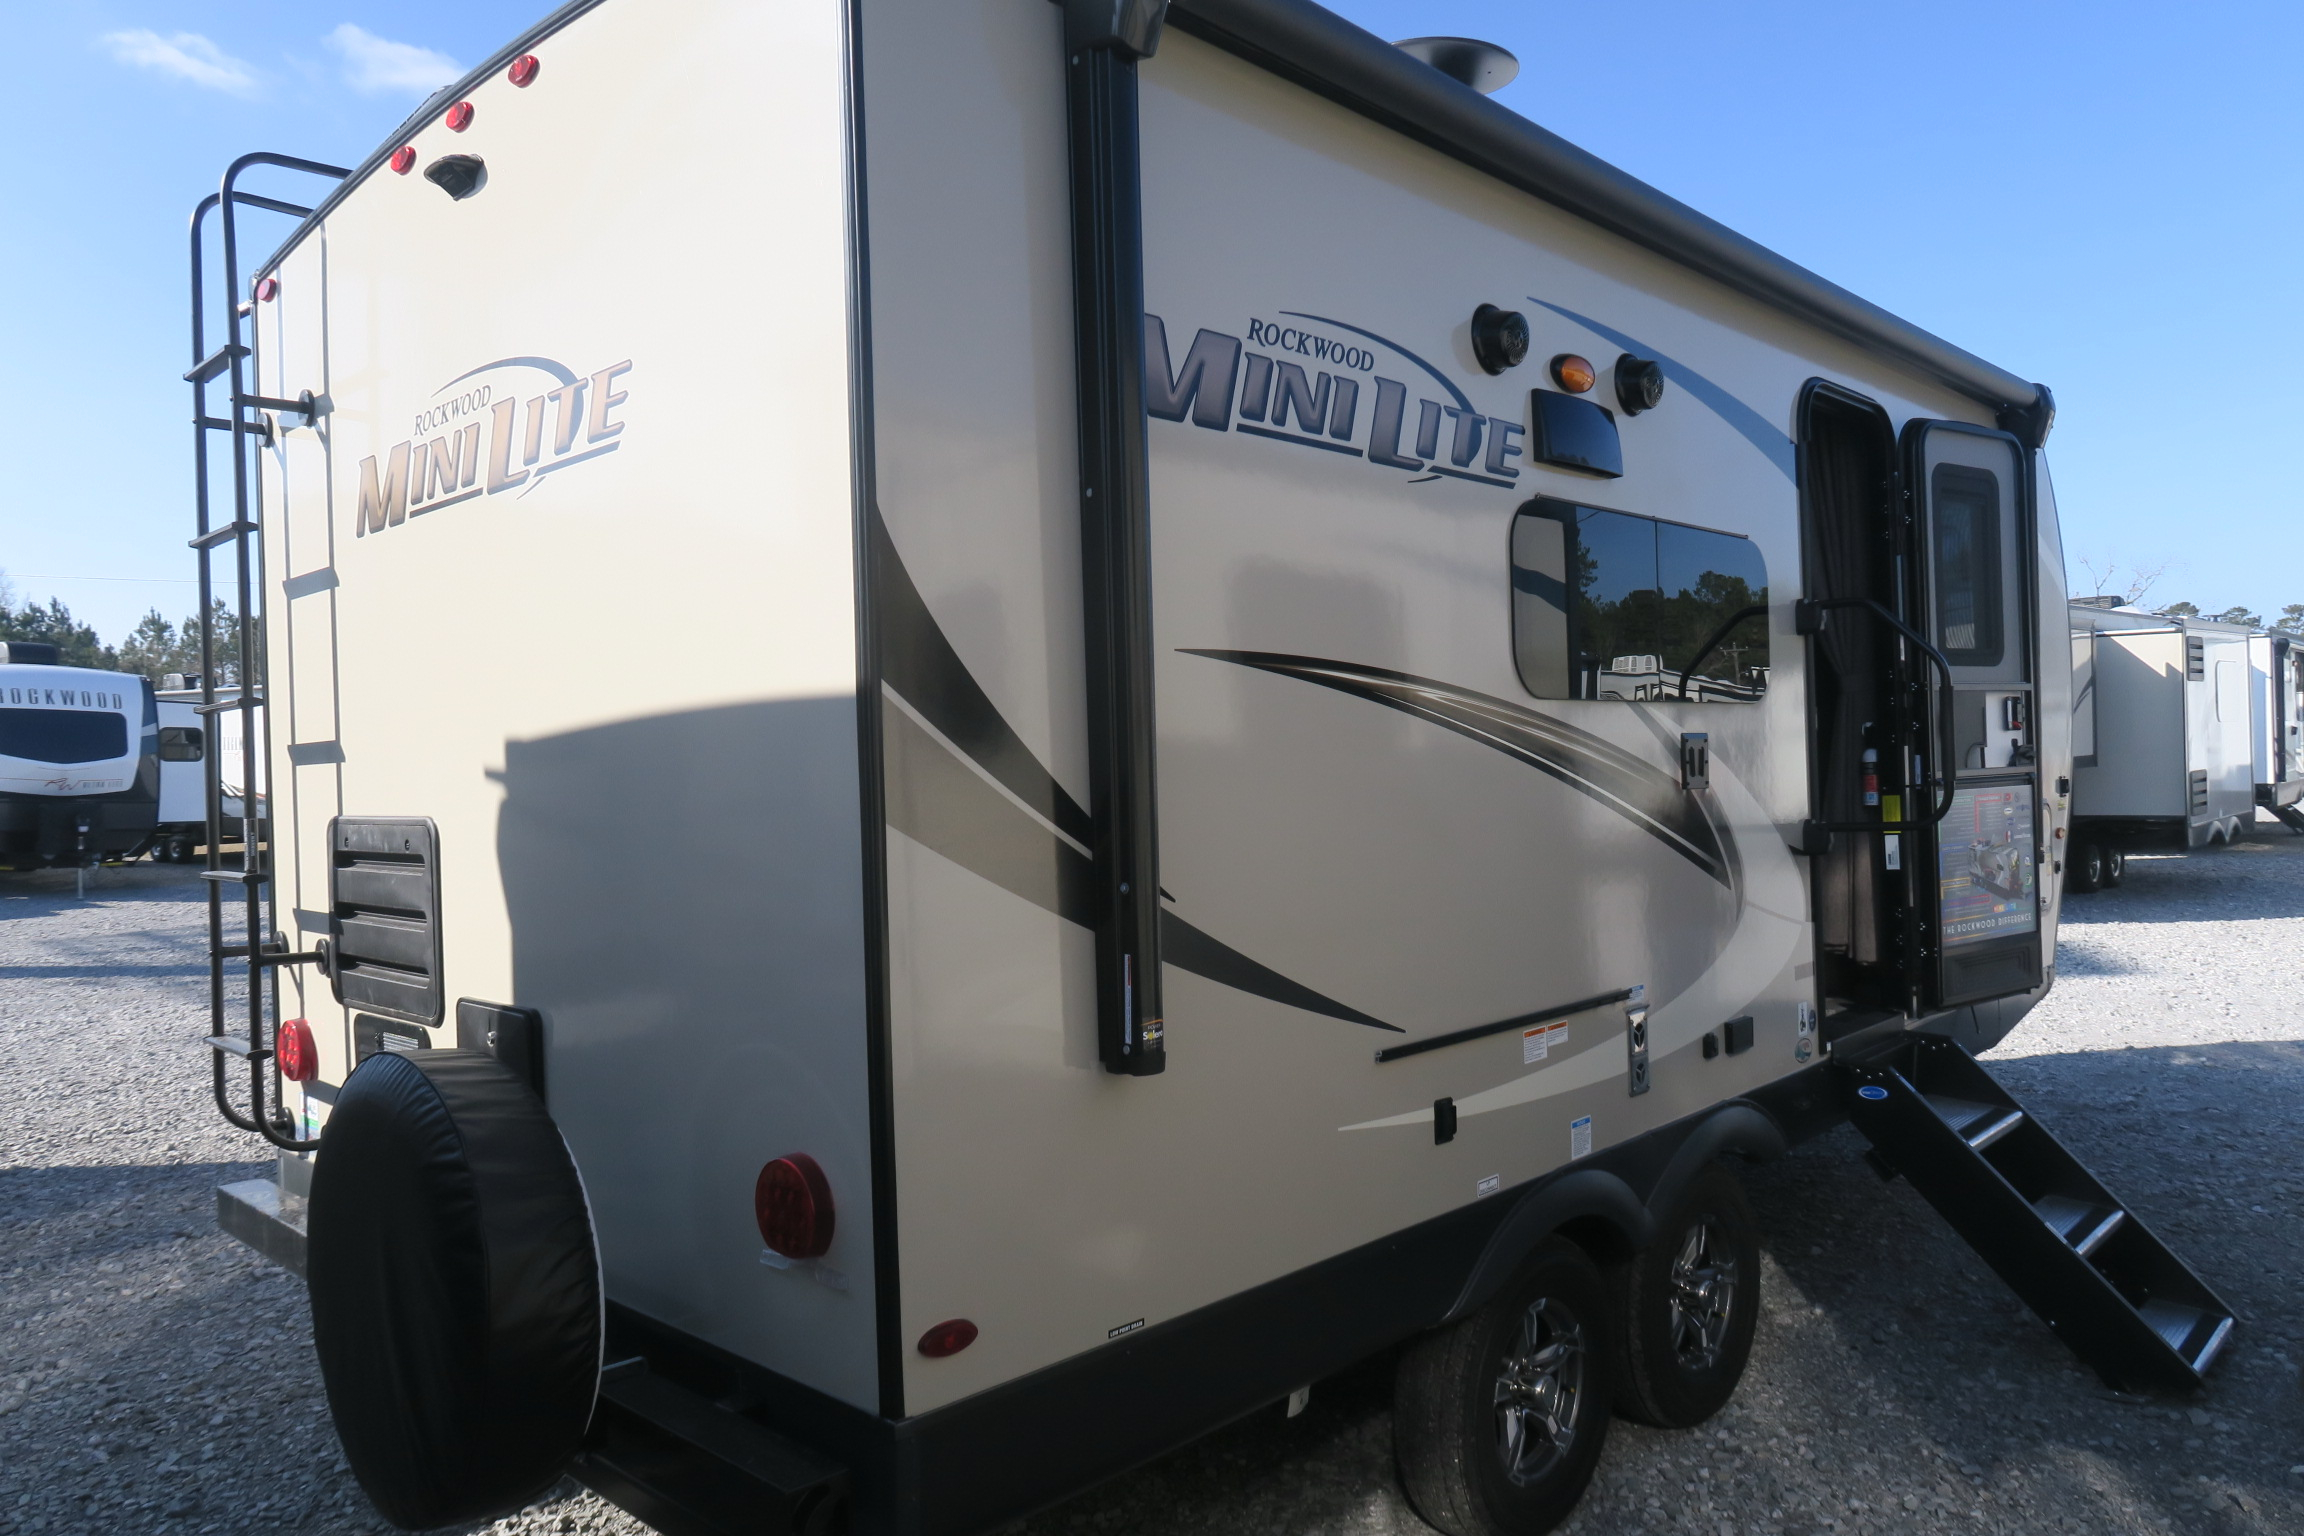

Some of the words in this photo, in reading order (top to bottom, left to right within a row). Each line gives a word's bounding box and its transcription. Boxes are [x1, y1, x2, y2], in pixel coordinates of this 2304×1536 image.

[1246, 317, 1375, 373] ROCKWOOD
[414, 384, 492, 436] ROCKWOOD
[1943, 923, 1955, 935] THE
[1957, 918, 1996, 933] ROCKWOOD
[1998, 913, 2032, 926] DIFFERENCE
